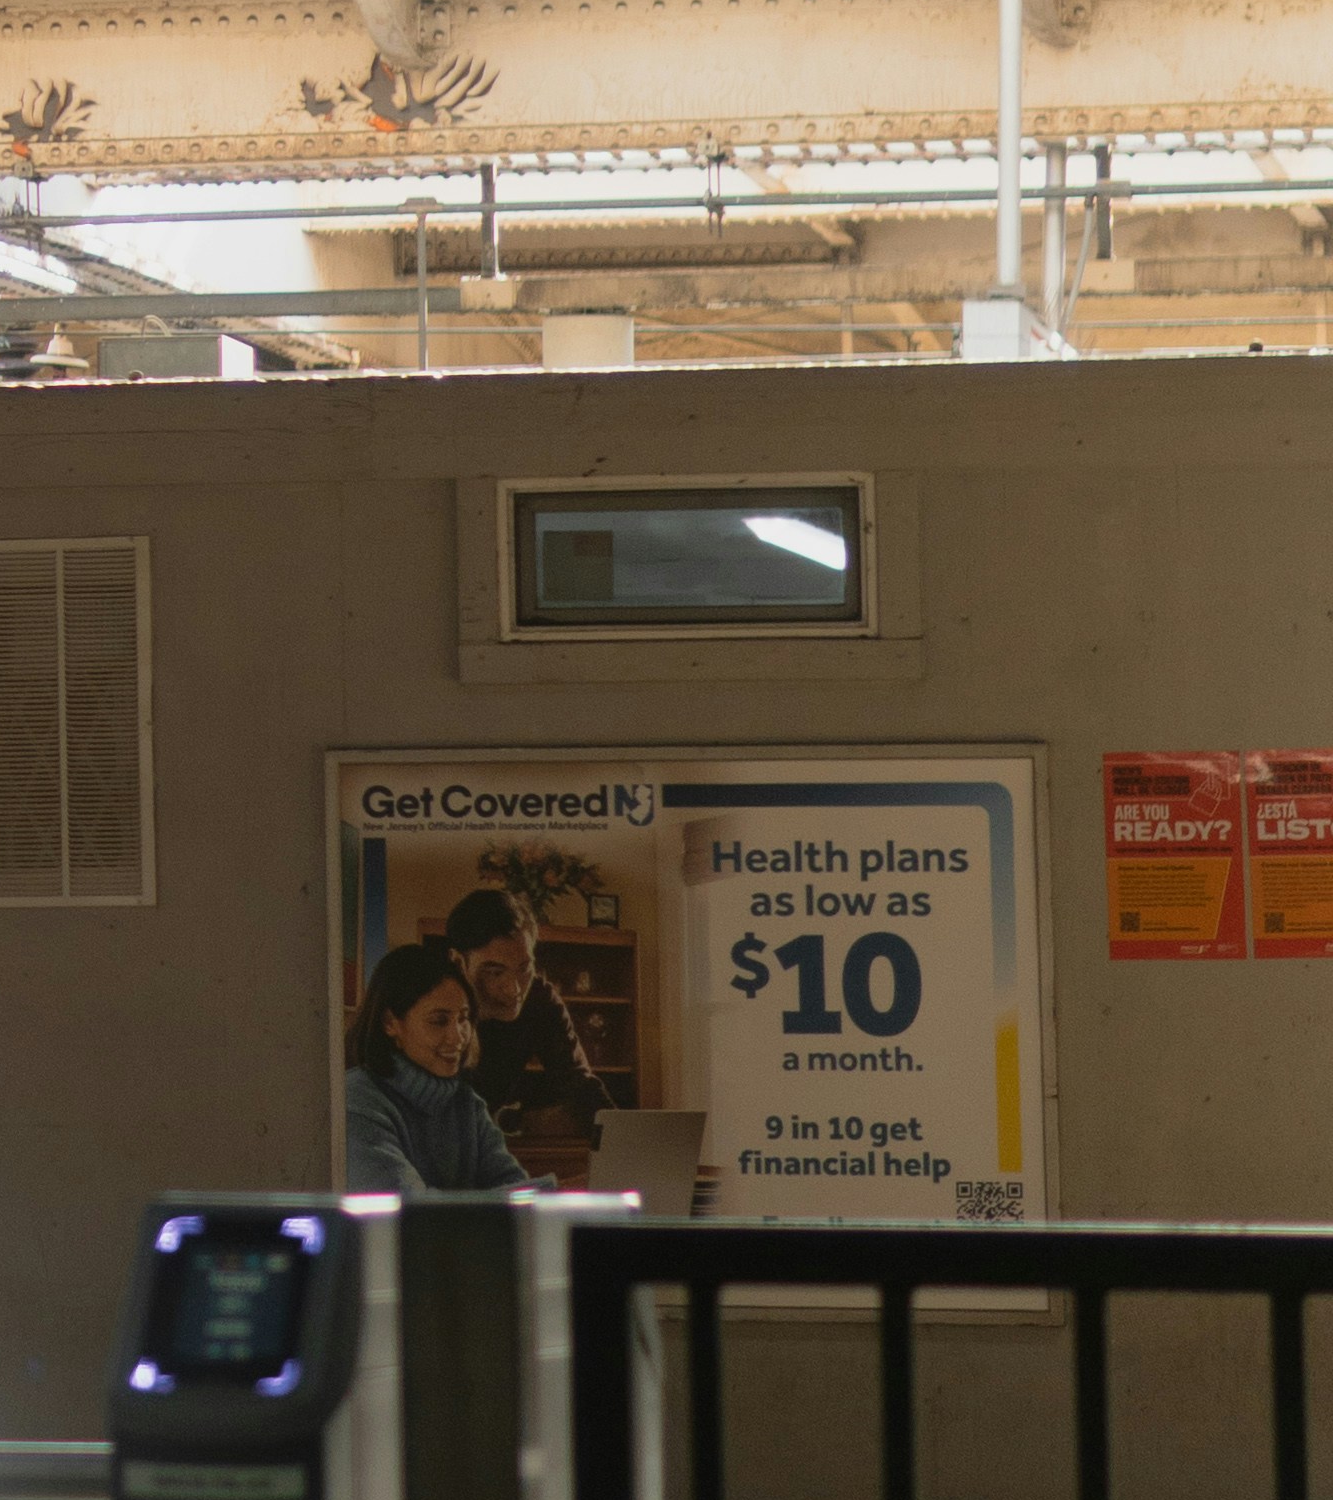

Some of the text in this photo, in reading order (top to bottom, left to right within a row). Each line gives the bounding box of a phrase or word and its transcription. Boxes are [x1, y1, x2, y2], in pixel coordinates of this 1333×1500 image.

[361, 784, 434, 819] Get
[440, 784, 608, 819] Covered
[1113, 803, 1171, 821] ARE YOU
[1256, 800, 1298, 820] ¿ESTÁ
[362, 821, 609, 834] New Jersey's Official Health Insurance Marketplace
[1113, 819, 1233, 842] READY?
[1256, 818, 1333, 841] LIST
[712, 839, 969, 881] Health plans
[749, 884, 932, 917] as low as
[730, 931, 922, 1037] $10
[782, 1046, 924, 1072] a month.
[765, 1114, 923, 1147] 9 in 10 get
[738, 1149, 951, 1182] financial help
